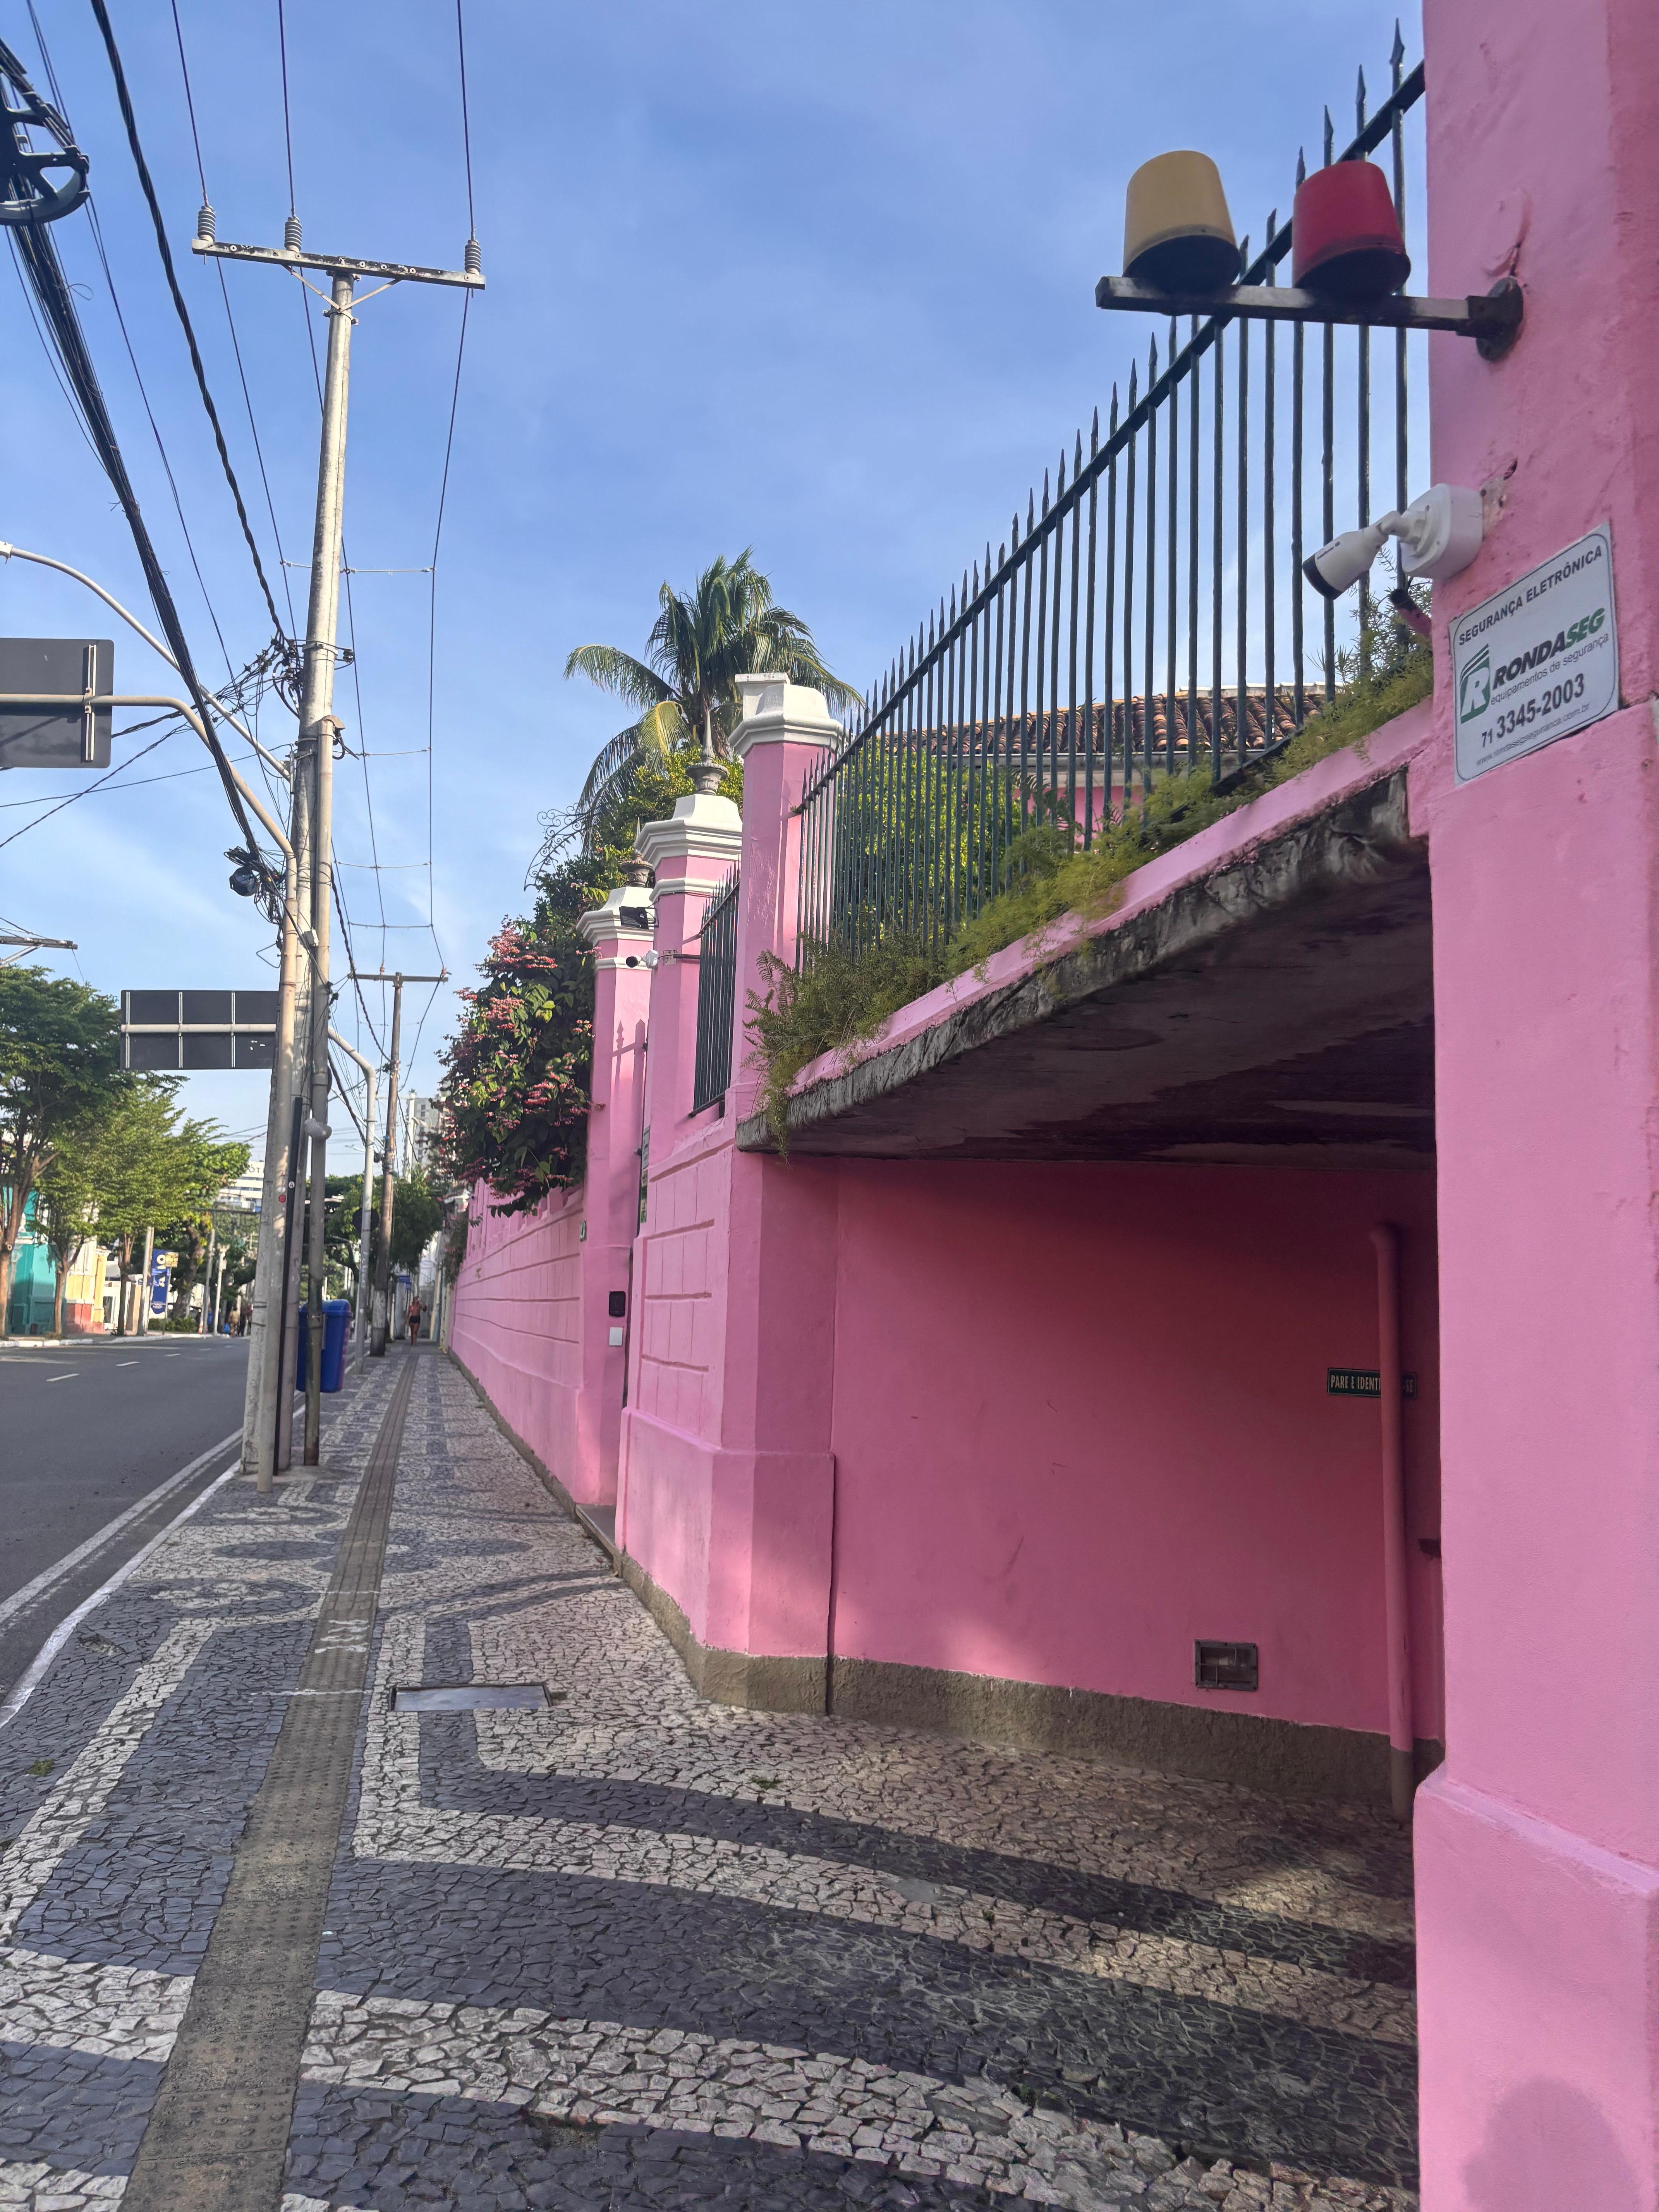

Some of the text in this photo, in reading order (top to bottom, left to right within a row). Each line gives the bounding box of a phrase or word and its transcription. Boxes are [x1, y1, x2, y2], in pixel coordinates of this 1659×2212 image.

[1459, 544, 1602, 646] SEGURANÇA ELETRÔNICA
[1491, 632, 1609, 706] equipamentos de segurança
[1492, 607, 1606, 690] RONDASEG
[1482, 673, 1585, 748] 71 3345-2003
[1331, 1375, 1348, 1389] PARE
[1351, 1376, 1355, 1389] E
